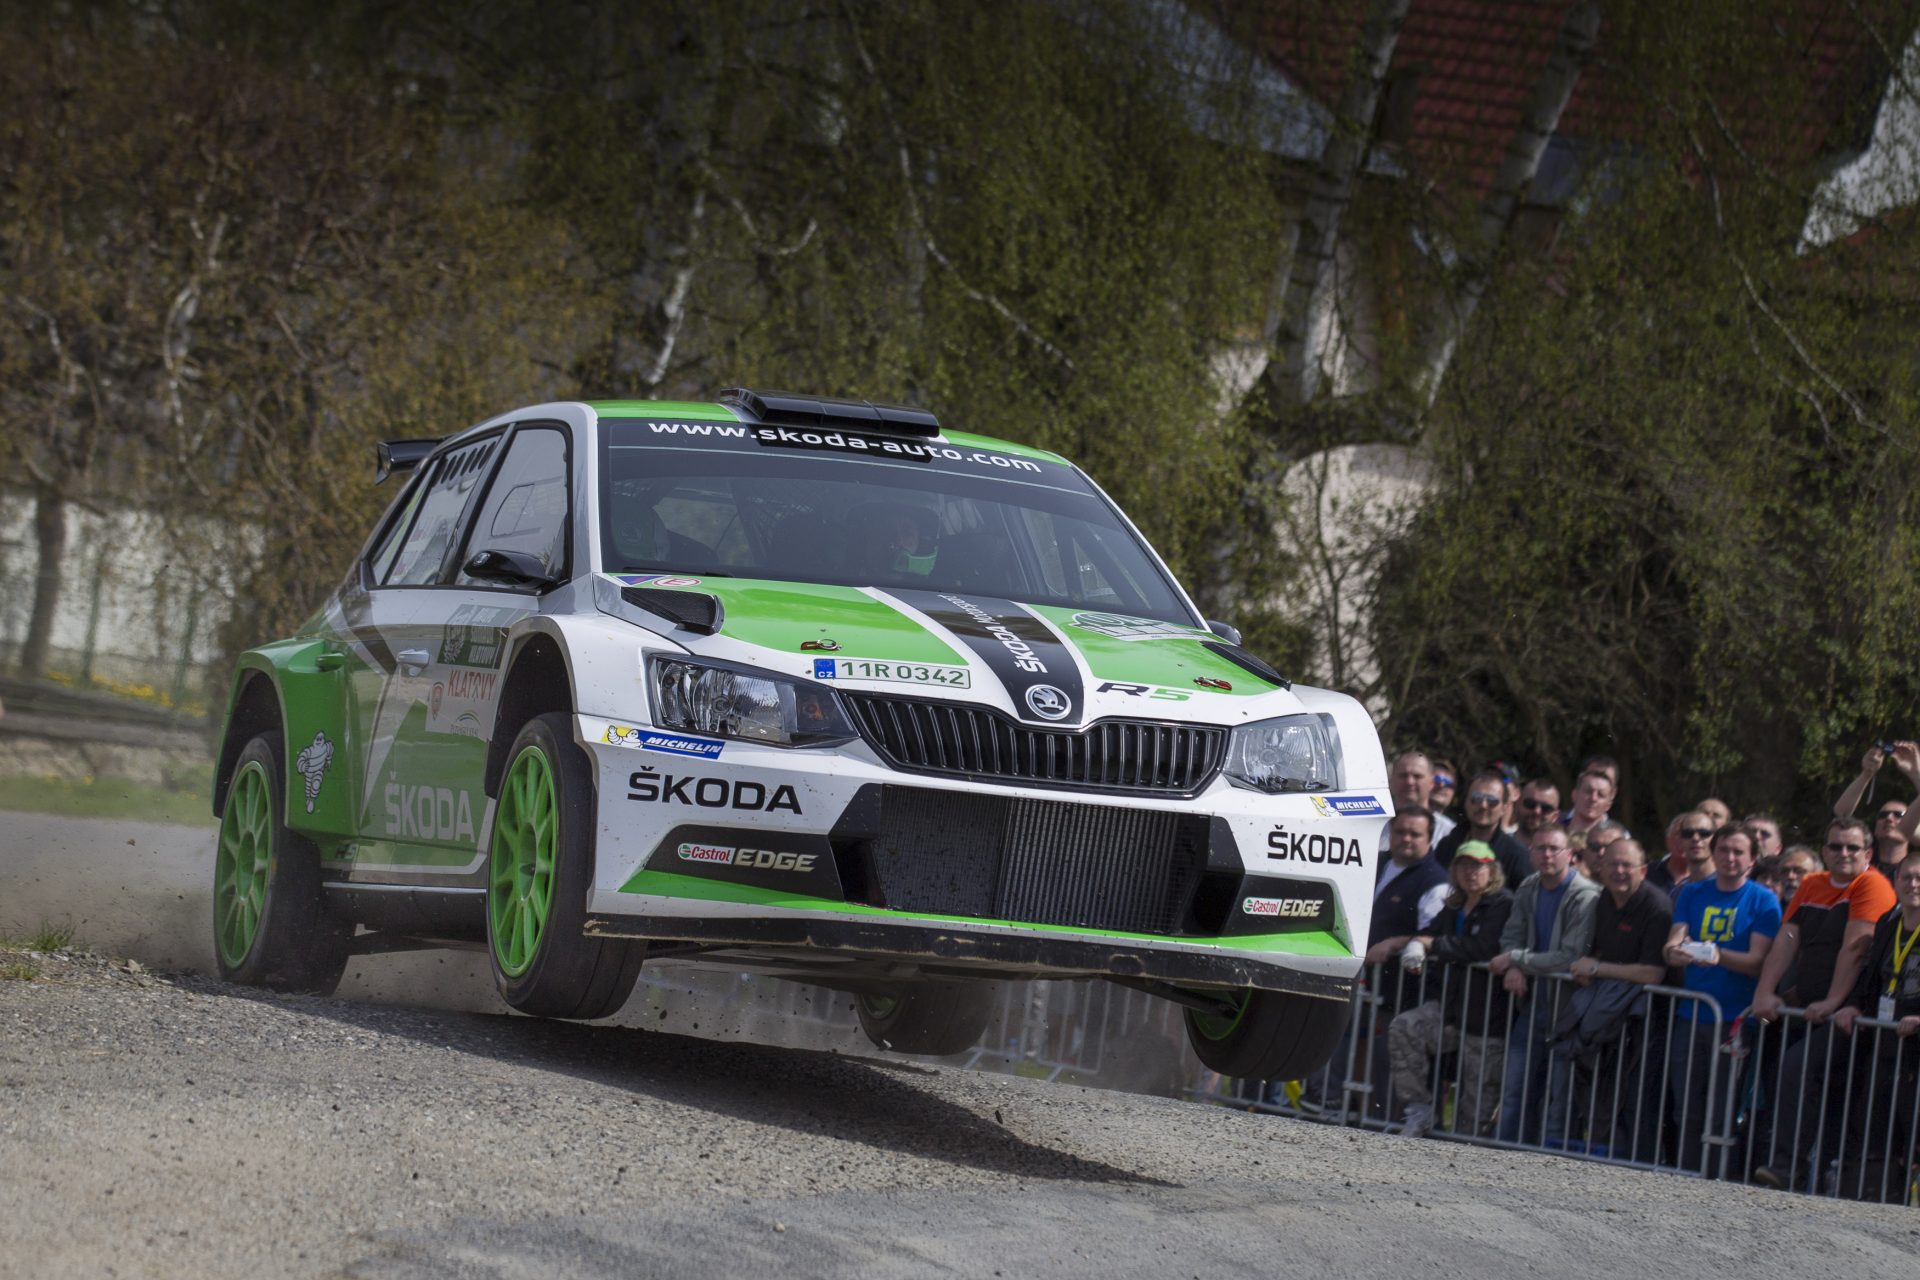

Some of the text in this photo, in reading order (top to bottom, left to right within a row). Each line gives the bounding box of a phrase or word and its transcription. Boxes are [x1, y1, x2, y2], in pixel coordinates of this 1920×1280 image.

[648, 423, 1042, 473] www.skoda-auto.com
[985, 626, 1049, 673] ŠKODA
[1096, 682, 1193, 701] R5
[647, 737, 722, 754] MICHELIN
[383, 771, 476, 843] ŠKODA
[627, 765, 803, 815] ŠKODA
[1336, 801, 1379, 811] MICHELIN
[691, 846, 819, 872] Castrol EDGE
[1267, 824, 1363, 867] ŠKODA
[1252, 899, 1325, 917] Castrol EDGE
